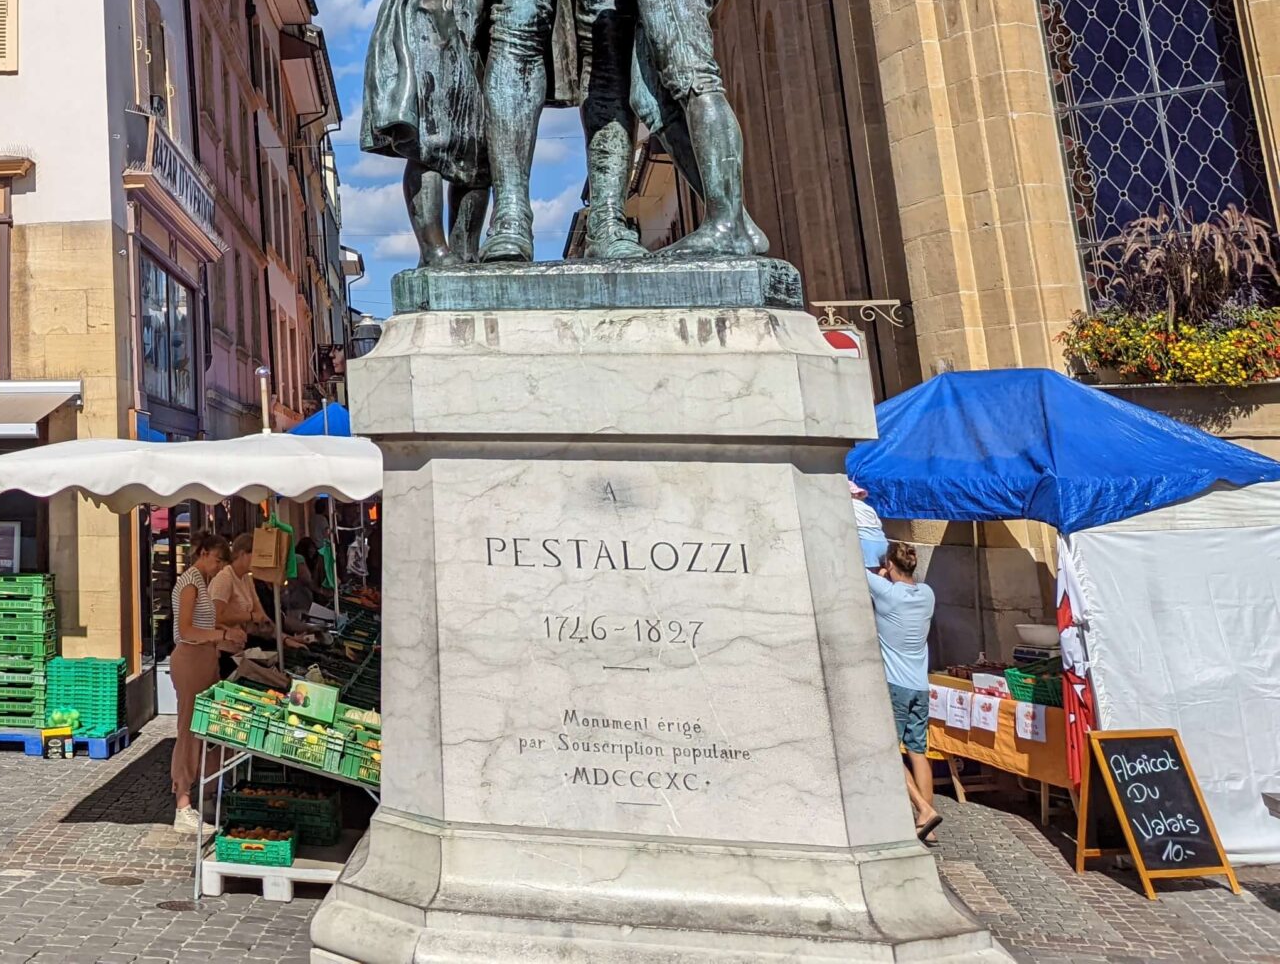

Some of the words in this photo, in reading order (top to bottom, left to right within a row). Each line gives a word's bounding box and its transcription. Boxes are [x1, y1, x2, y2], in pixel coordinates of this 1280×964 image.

[601, 481, 617, 502] A
[485, 537, 751, 575] PESTALOZZI
[563, 709, 648, 731] Monument
[658, 716, 702, 740] érigé
[519, 736, 546, 754] par
[557, 733, 665, 762] Souscription
[672, 744, 751, 765] populaire
[1132, 810, 1201, 840] Valais
